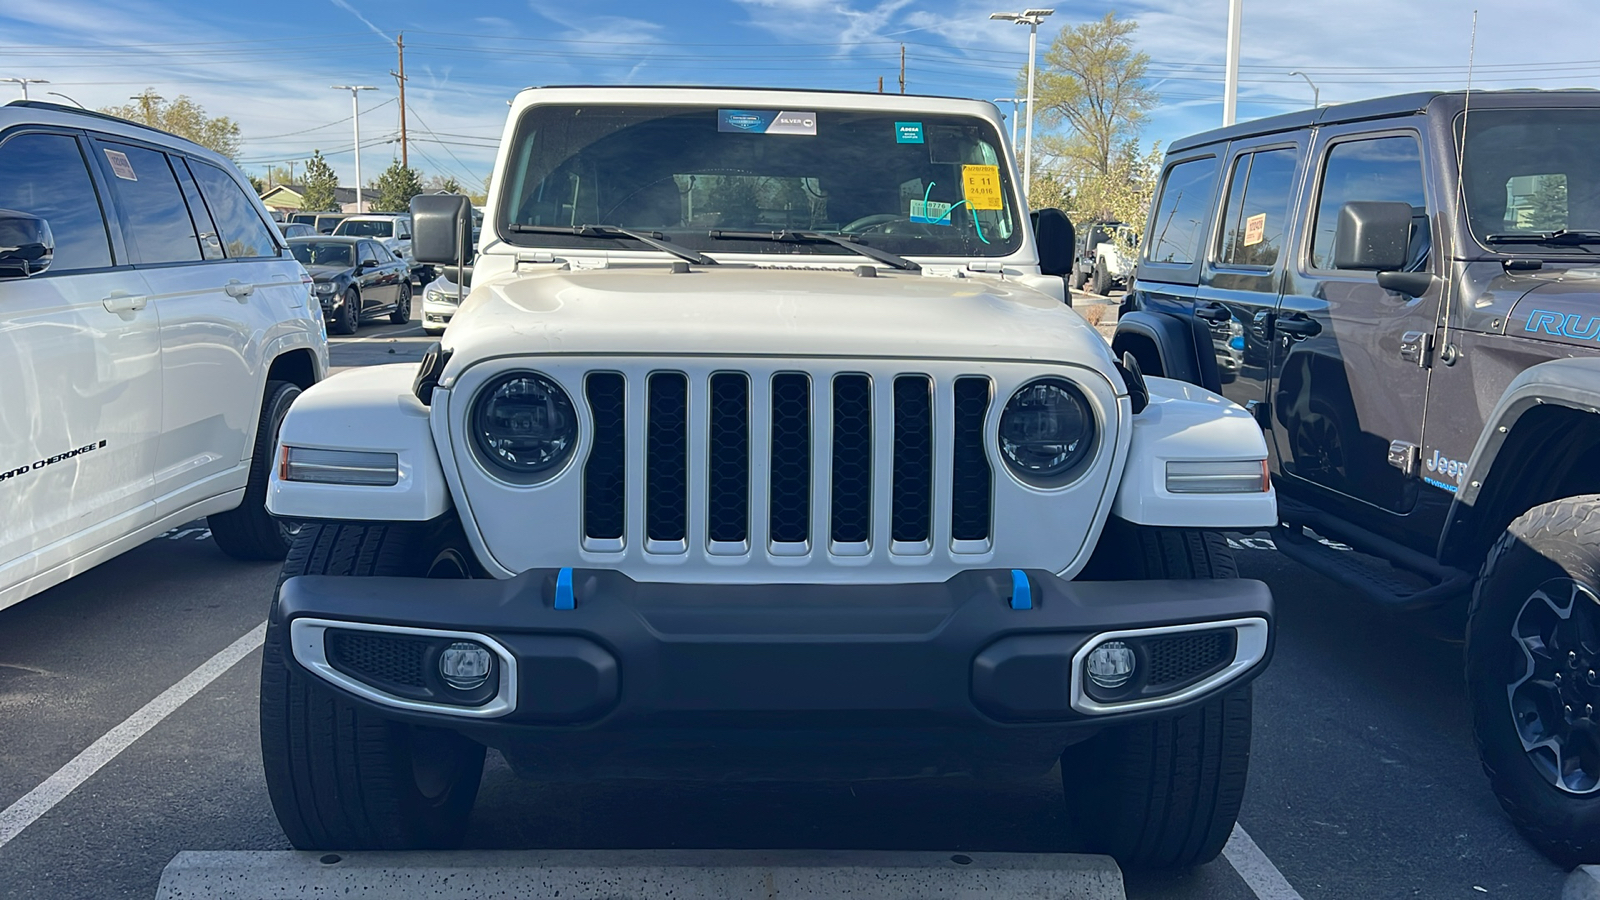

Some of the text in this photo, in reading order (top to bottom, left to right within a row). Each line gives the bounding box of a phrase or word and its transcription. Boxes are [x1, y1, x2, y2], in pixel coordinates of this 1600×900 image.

[969, 177, 991, 185] E 11
[1525, 309, 1600, 341] RU
[0, 442, 97, 481] AND CHEROKEE
[1426, 449, 1468, 485] Jeep
[1430, 479, 1459, 492] WRANG
